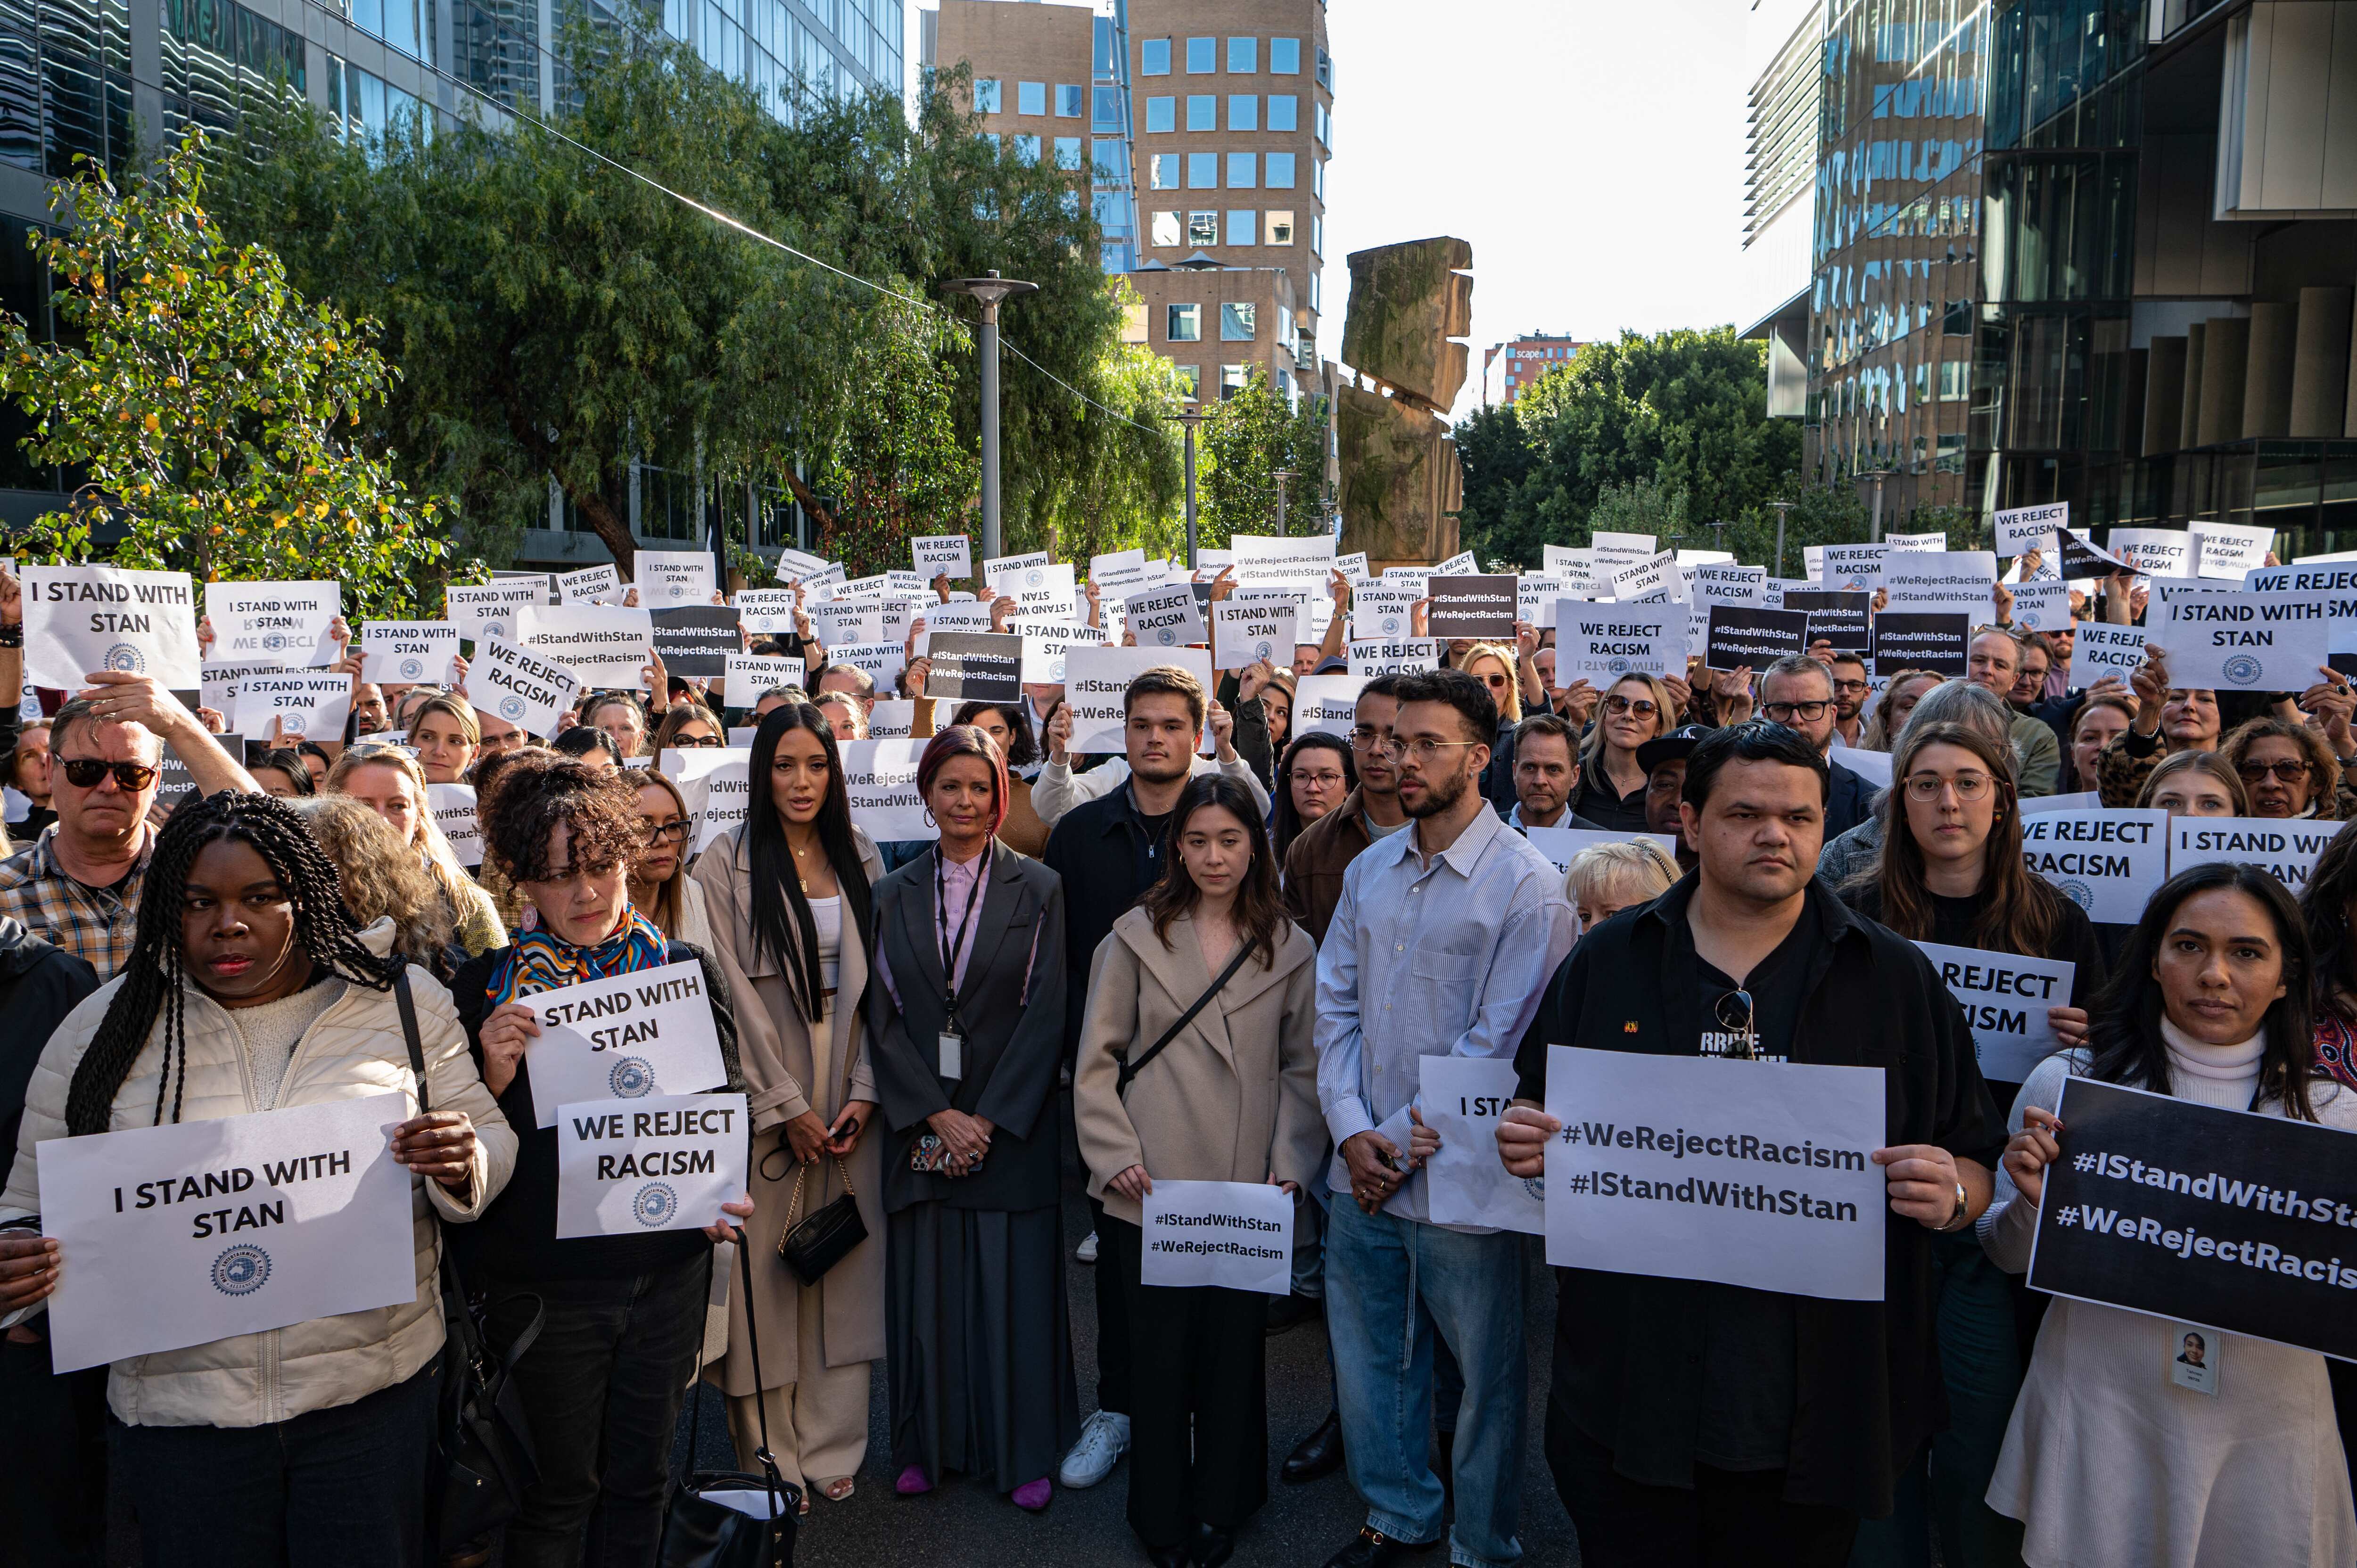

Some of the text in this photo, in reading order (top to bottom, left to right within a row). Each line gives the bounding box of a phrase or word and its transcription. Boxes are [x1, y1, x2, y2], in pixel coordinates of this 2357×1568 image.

[1517, 350, 1540, 361] scape
[1999, 508, 2064, 525] WE REJECT
[2009, 525, 2056, 539] RACISM
[916, 540, 964, 550] WE REJECT
[2202, 536, 2253, 548] WE REJECT
[1597, 547, 1649, 555] #IStandWithStan
[1828, 551, 1846, 560] WE
[2124, 544, 2184, 556] WE REJECT
[2206, 548, 2243, 558] RACISM
[924, 553, 960, 562] RACISM
[1238, 555, 1330, 566] #WeRejectRacism
[993, 563, 1021, 573] STAND
[1023, 558, 1046, 566] WITH
[1619, 565, 1648, 581] STAND
[1650, 554, 1674, 570] WITH
[1836, 565, 1880, 574] RACISM
[562, 570, 612, 586] WE REJECT
[1098, 567, 1140, 577] #IStandWithStan
[1240, 568, 1327, 578] #IStandWithStan
[1699, 570, 1717, 580] WE
[1721, 571, 1762, 583] REJECT
[1636, 574, 1659, 589] STAN
[1889, 575, 1991, 586] #WeRejectRacism
[2255, 575, 2289, 591] WE
[573, 583, 610, 598] RACISM
[1533, 583, 1559, 592] WITH
[1706, 586, 1752, 598] RACISM
[2038, 586, 2066, 595] WITH
[32, 583, 187, 605] I STAND WITH
[450, 591, 533, 602] I STAND WITH
[741, 595, 754, 603] WE
[1022, 591, 1049, 601] STAN
[1362, 593, 1395, 601] STAND
[1397, 593, 1421, 601] WITH
[1434, 593, 1511, 602] #IStandWithStan
[1891, 592, 1988, 601] #IStandWithStan
[230, 601, 317, 612] I STAND WITH
[1031, 604, 1066, 613] STAND
[1129, 602, 1146, 614] WE
[1148, 594, 1188, 611] REJECT
[2017, 600, 2044, 609] STAN
[477, 607, 509, 616] STAN
[746, 607, 786, 616] RACISM
[824, 606, 853, 616] STAND
[856, 605, 879, 614] WITH
[1220, 610, 1223, 621] I
[1227, 607, 1267, 621] STAND
[1269, 607, 1294, 618] WITH
[1432, 611, 1513, 620] #WeRejectRacism
[2173, 605, 2177, 620] I
[2183, 605, 2254, 621] STAND
[2260, 603, 2322, 621] WITH
[91, 614, 150, 632] STAN
[257, 617, 291, 627] STAN
[838, 618, 862, 626] STAN
[1138, 613, 1186, 631] RACISM
[367, 629, 456, 638] I STAND WITH
[1018, 625, 1105, 641] I STAND WITH
[1248, 624, 1276, 636] STAN
[1580, 623, 1661, 637] WE REJECT
[1714, 626, 1798, 640] #IStandWithStan
[528, 631, 642, 645] #IStandWithStan
[1879, 632, 1961, 641] #IStandWithStan
[2083, 630, 2105, 643] WE
[2212, 631, 2273, 646] STAN
[395, 644, 429, 653] STAN
[837, 649, 872, 658] STAND
[875, 646, 903, 655] WITH
[1353, 644, 1432, 658] WE REJECT
[1590, 643, 1650, 655] RACISM
[1712, 642, 1798, 656] #WeRejectRacism
[1878, 649, 1962, 660] #WeRejectRacism
[932, 651, 1014, 664] #IStandWithStan
[489, 641, 575, 693] WE REJECT
[730, 661, 800, 673] I STAND WITH
[1365, 665, 1423, 675] RACISM
[751, 675, 778, 684] STAN
[929, 668, 1016, 682] #WeRejectRacism
[243, 681, 347, 691] I STAND WITH
[488, 668, 556, 708] RACISM
[274, 697, 314, 707] STAN
[2054, 822, 2153, 843] REJECT
[2182, 832, 2285, 852] I STAND
[2026, 854, 2130, 878] RACISM
[1942, 962, 2058, 999] REJECT
[545, 976, 700, 1026] STAND WITH
[1958, 1003, 2026, 1034] ISM
[591, 1018, 659, 1051] STAN
[1461, 1097, 1466, 1116] I
[573, 1109, 735, 1141] WE REJECT
[1563, 1122, 1865, 1172] #WeRejectRacism
[598, 1149, 714, 1180] RACISM
[114, 1150, 350, 1213] I STAND WITH
[1570, 1171, 1857, 1222] #IStandWithStan
[193, 1200, 284, 1239] STAN
[1155, 1214, 1281, 1232] #IStandWithStan
[1151, 1240, 1283, 1259] #WeRejectRacism
[223, 1252, 258, 1266] ENTERTAINMENT
[230, 1281, 255, 1289] ALLIANCE
